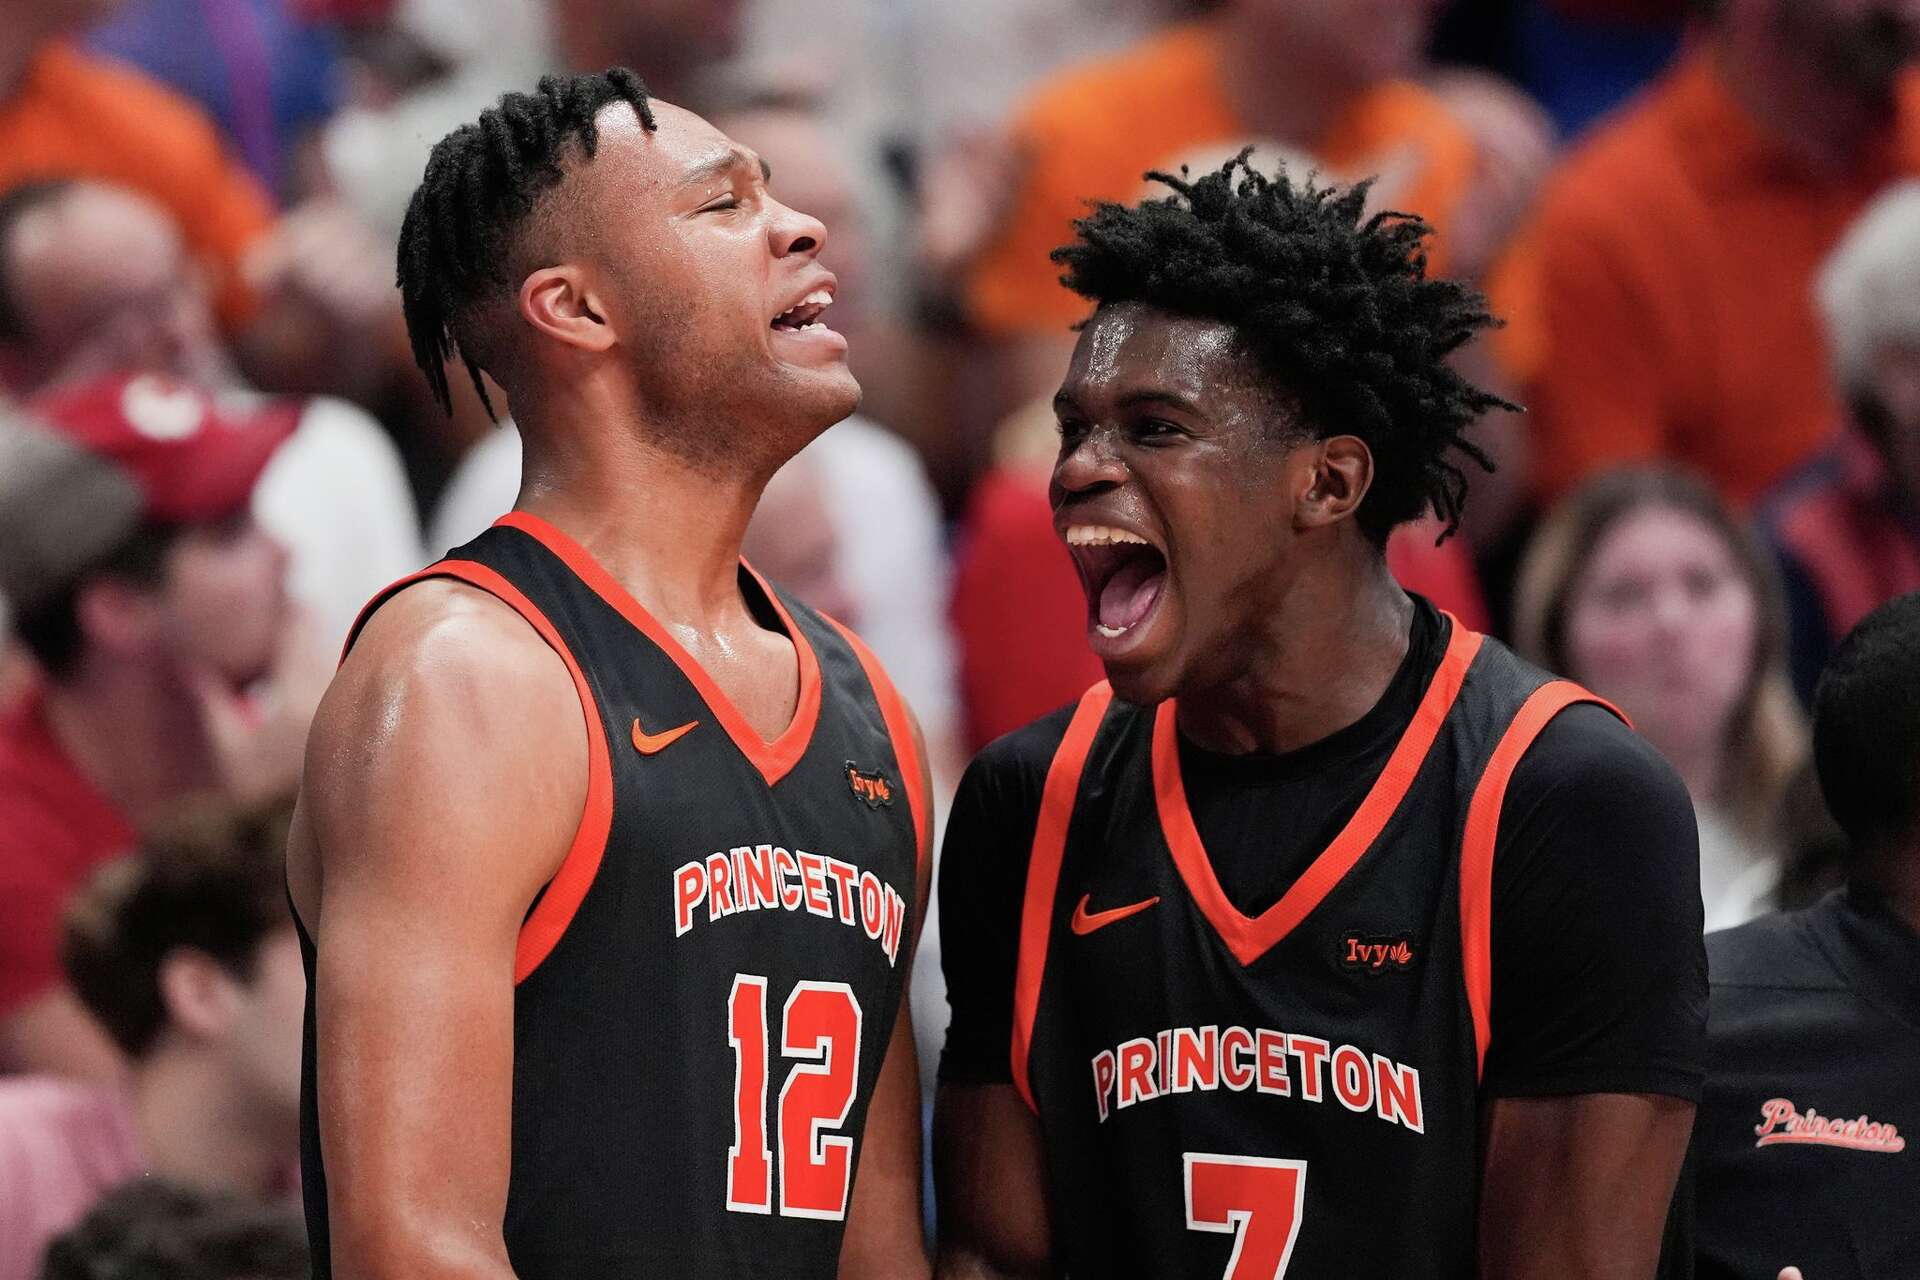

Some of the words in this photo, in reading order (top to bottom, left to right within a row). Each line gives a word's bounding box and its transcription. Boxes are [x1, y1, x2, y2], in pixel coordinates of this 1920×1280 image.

[674, 844, 905, 967] PRINCETON
[1346, 938, 1390, 968] Ivy
[726, 973, 862, 1221] 12
[1091, 1025, 1425, 1134] PRINCETON
[1755, 1098, 1900, 1146] Princeton
[1182, 1152, 1308, 1280] 7
